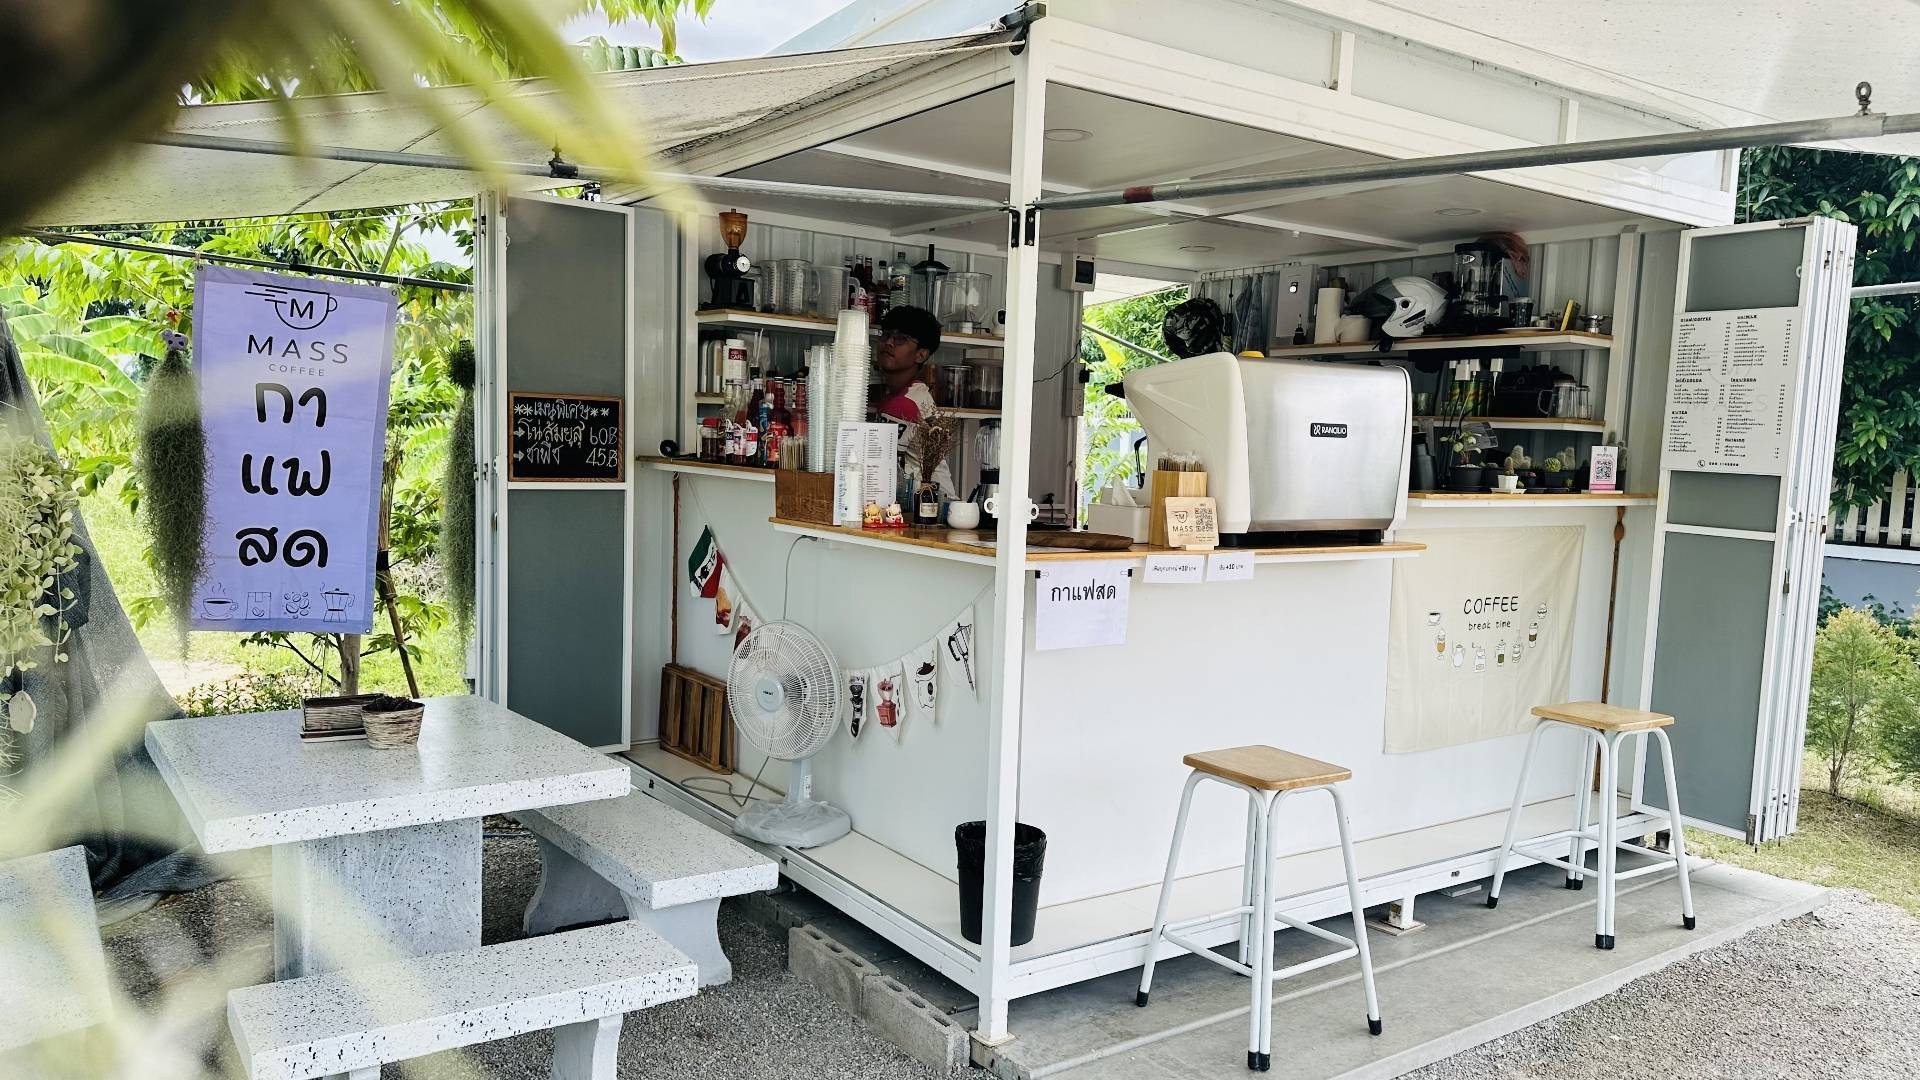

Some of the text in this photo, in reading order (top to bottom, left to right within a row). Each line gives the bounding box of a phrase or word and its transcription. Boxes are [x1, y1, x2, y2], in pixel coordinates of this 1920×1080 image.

[289, 298, 314, 320] M
[247, 334, 348, 364] MASS
[268, 363, 325, 377] COFFEE
[255, 382, 328, 428] กา
[1321, 426, 1347, 435] RANCILIO
[241, 449, 332, 497] แฟ
[1172, 525, 1195, 533] MASS
[235, 526, 329, 568] สด
[1051, 578, 1117, 602] กาแฟสด
[1463, 596, 1520, 615] COFFEE
[1468, 620, 1511, 631] break time
